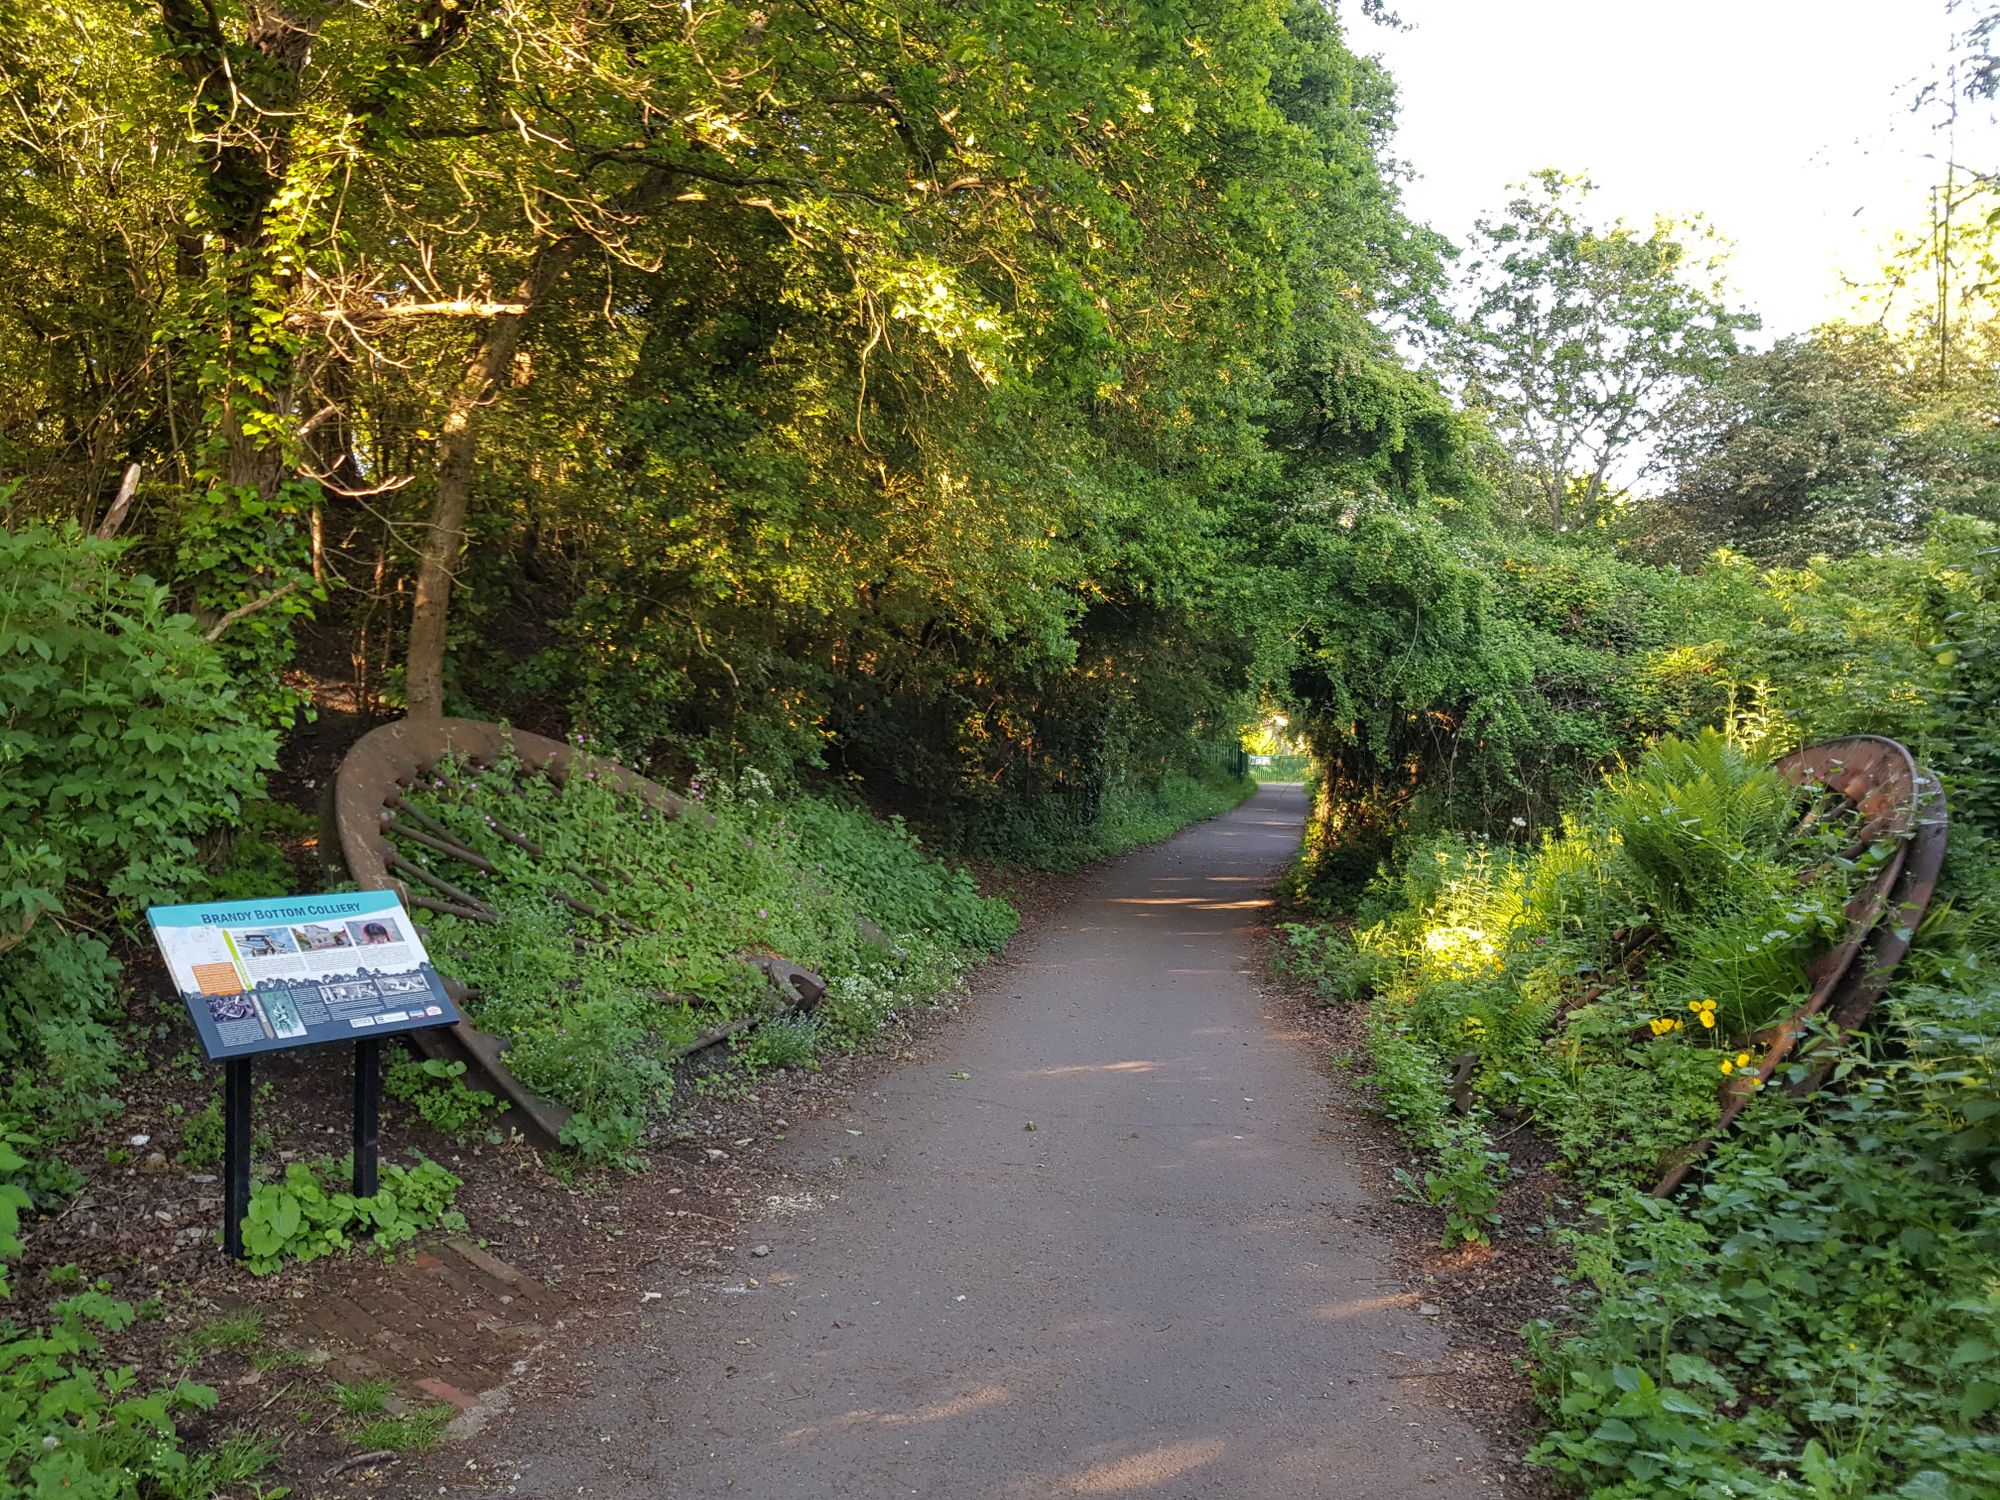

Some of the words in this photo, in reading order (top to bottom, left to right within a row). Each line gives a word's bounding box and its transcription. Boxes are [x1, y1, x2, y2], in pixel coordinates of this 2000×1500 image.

[201, 911, 251, 924] BRANDY
[254, 907, 305, 920] BOTTOM
[307, 902, 361, 916] COLLIERY
